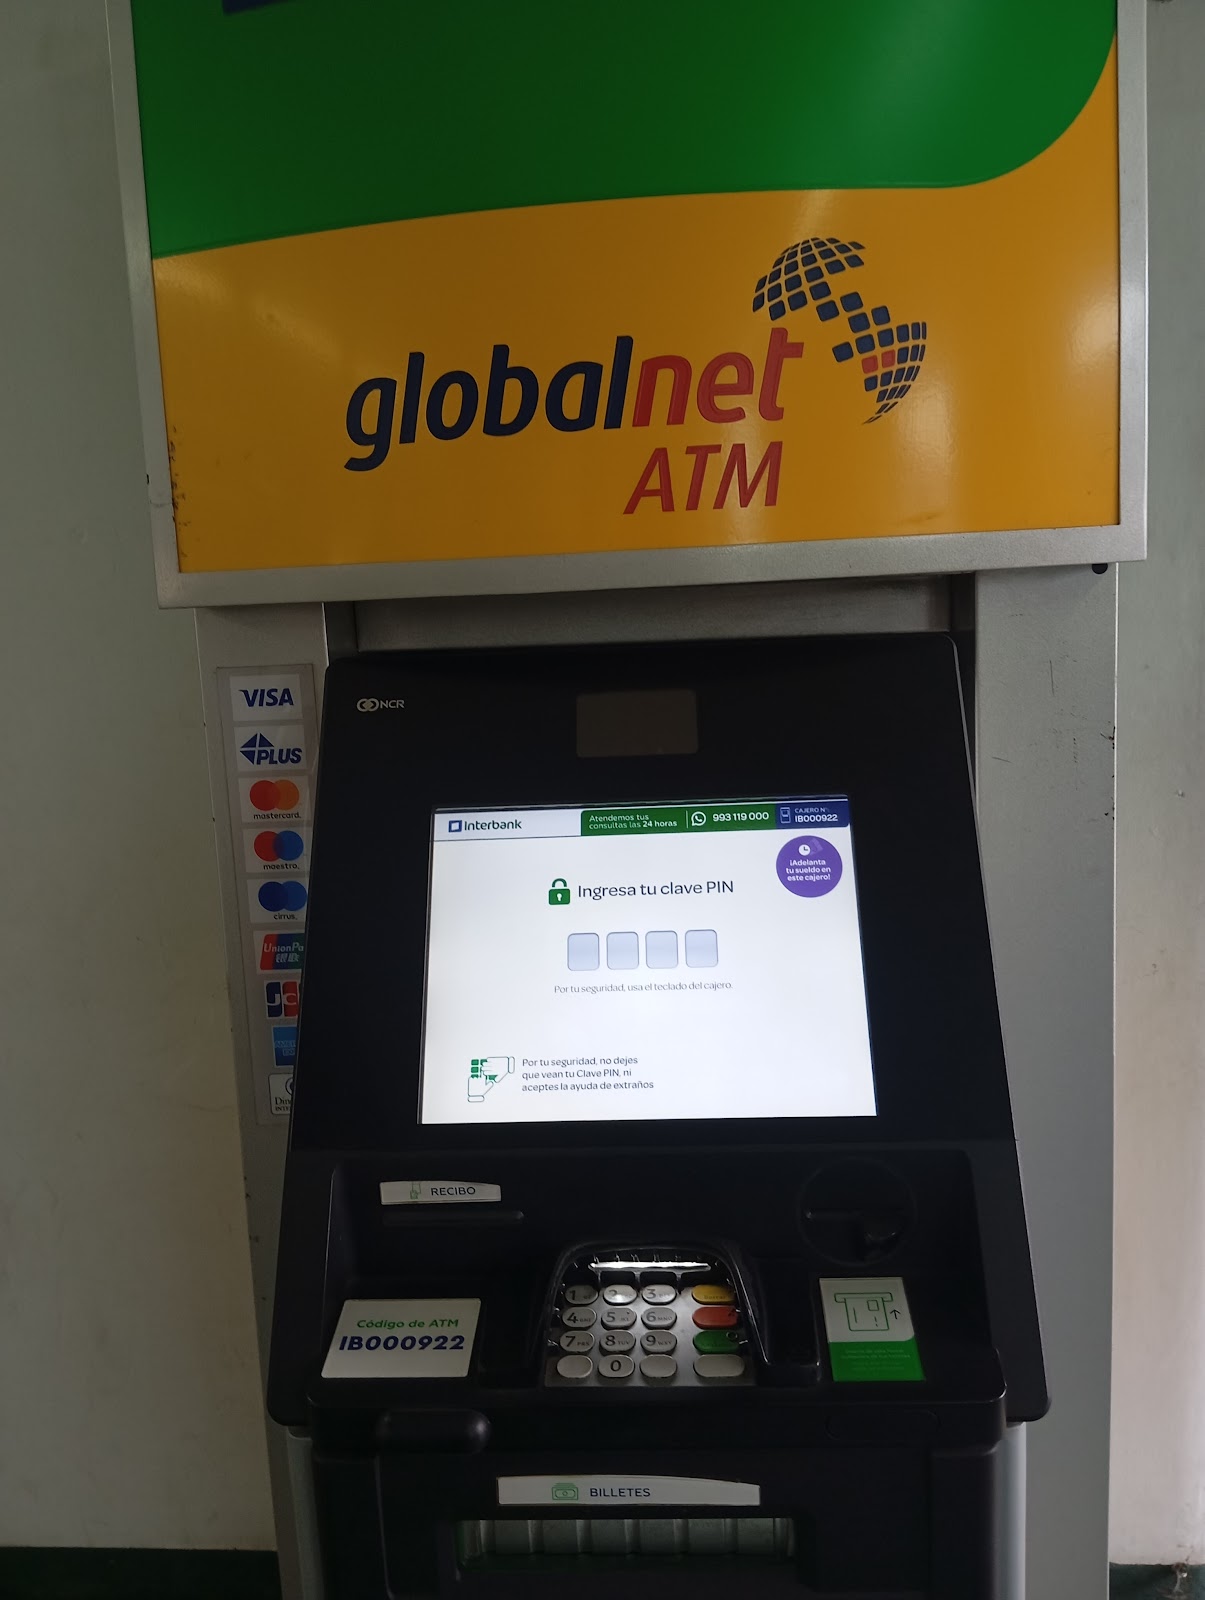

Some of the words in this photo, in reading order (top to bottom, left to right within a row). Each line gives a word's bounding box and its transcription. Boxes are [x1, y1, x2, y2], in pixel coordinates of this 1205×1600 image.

[343, 327, 804, 473] globalnet
[623, 441, 783, 515] ATM
[239, 688, 294, 707] VISA
[380, 699, 405, 709] NCR
[256, 747, 303, 765] PLUS
[589, 814, 634, 822] Atendemos
[712, 812, 731, 822] 993
[733, 812, 748, 821] 119
[749, 811, 769, 821] 000
[794, 813, 838, 823] IB000922
[464, 819, 522, 831] Interbank
[588, 821, 627, 830] consultas
[629, 820, 641, 828] las
[642, 820, 653, 828] 24
[804, 873, 831, 882] cajero!
[578, 884, 636, 900] Ingresa
[640, 884, 657, 896] tu
[660, 882, 703, 895] clave
[706, 881, 734, 894] PIN
[263, 941, 304, 953] UnionPa
[554, 985, 568, 994] Por
[570, 985, 580, 993] tu
[581, 983, 626, 995] seguridad,
[644, 982, 653, 991] el
[654, 982, 688, 991] teclado
[688, 981, 703, 990] del
[703, 981, 733, 991] cajero.
[267, 993, 297, 1006] JC
[522, 1058, 539, 1067] Por
[539, 1058, 550, 1066] tu
[551, 1057, 598, 1068] seguridad,
[613, 1056, 638, 1067] dejes
[521, 1071, 540, 1080] que
[541, 1071, 564, 1079] vean
[565, 1070, 575, 1078] tu
[576, 1069, 601, 1078] Clave
[603, 1069, 621, 1078] PIN,
[622, 1068, 632, 1077] ni
[521, 1083, 559, 1093] aceptes
[560, 1082, 569, 1091] la
[569, 1082, 598, 1092] ayuda
[599, 1081, 612, 1090] de
[613, 1079, 654, 1090] extraños
[430, 1186, 476, 1196] RECIBO
[569, 1289, 576, 1300] 1
[646, 1288, 656, 1299] 3
[567, 1312, 578, 1323] 4
[606, 1311, 616, 1322] 5
[646, 1311, 656, 1322] 6
[356, 1319, 404, 1330] Código
[408, 1319, 425, 1328] de
[428, 1319, 459, 1328] ATM
[339, 1335, 465, 1351] IB000922
[565, 1335, 577, 1347] 7
[605, 1335, 616, 1347] 8
[646, 1335, 656, 1347] 9
[610, 1360, 621, 1372] 0
[589, 1487, 651, 1498] BILLETES
